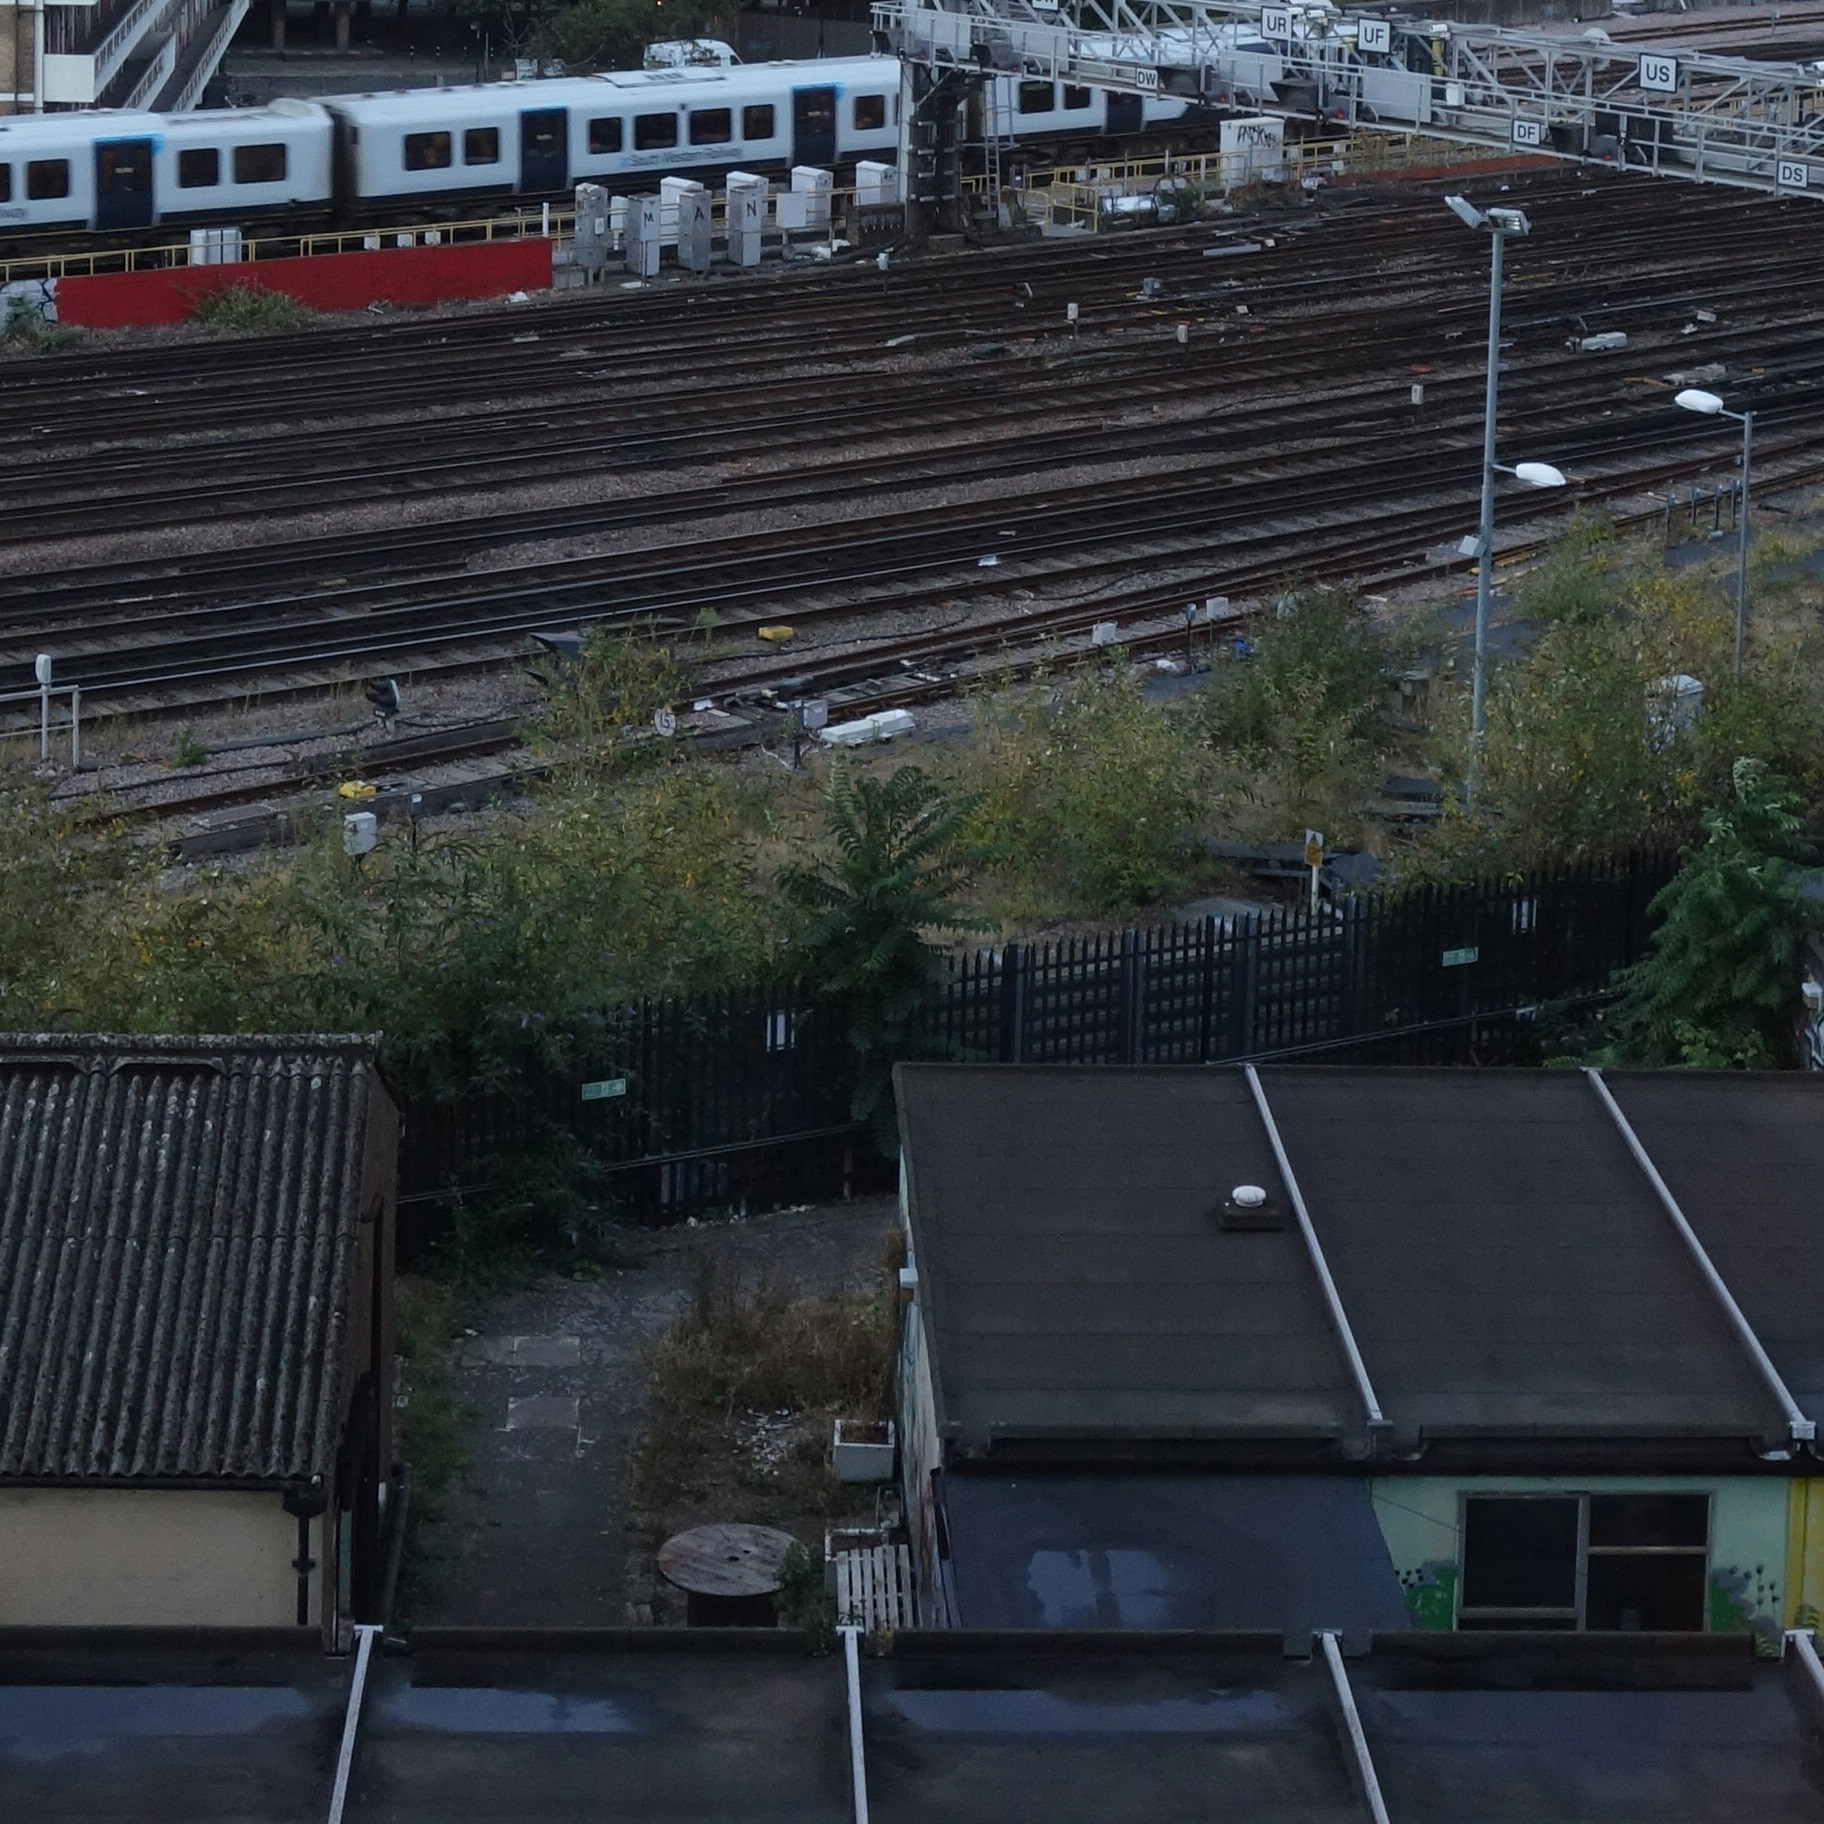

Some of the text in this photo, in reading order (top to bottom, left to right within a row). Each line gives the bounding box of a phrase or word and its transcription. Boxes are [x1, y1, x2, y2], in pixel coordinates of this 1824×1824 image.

[1266, 15, 1287, 33] UR
[1364, 26, 1385, 44] UF
[1137, 70, 1157, 86] DW
[1646, 62, 1670, 83] US
[1517, 126, 1537, 140] DF
[1781, 164, 1804, 182] DS
